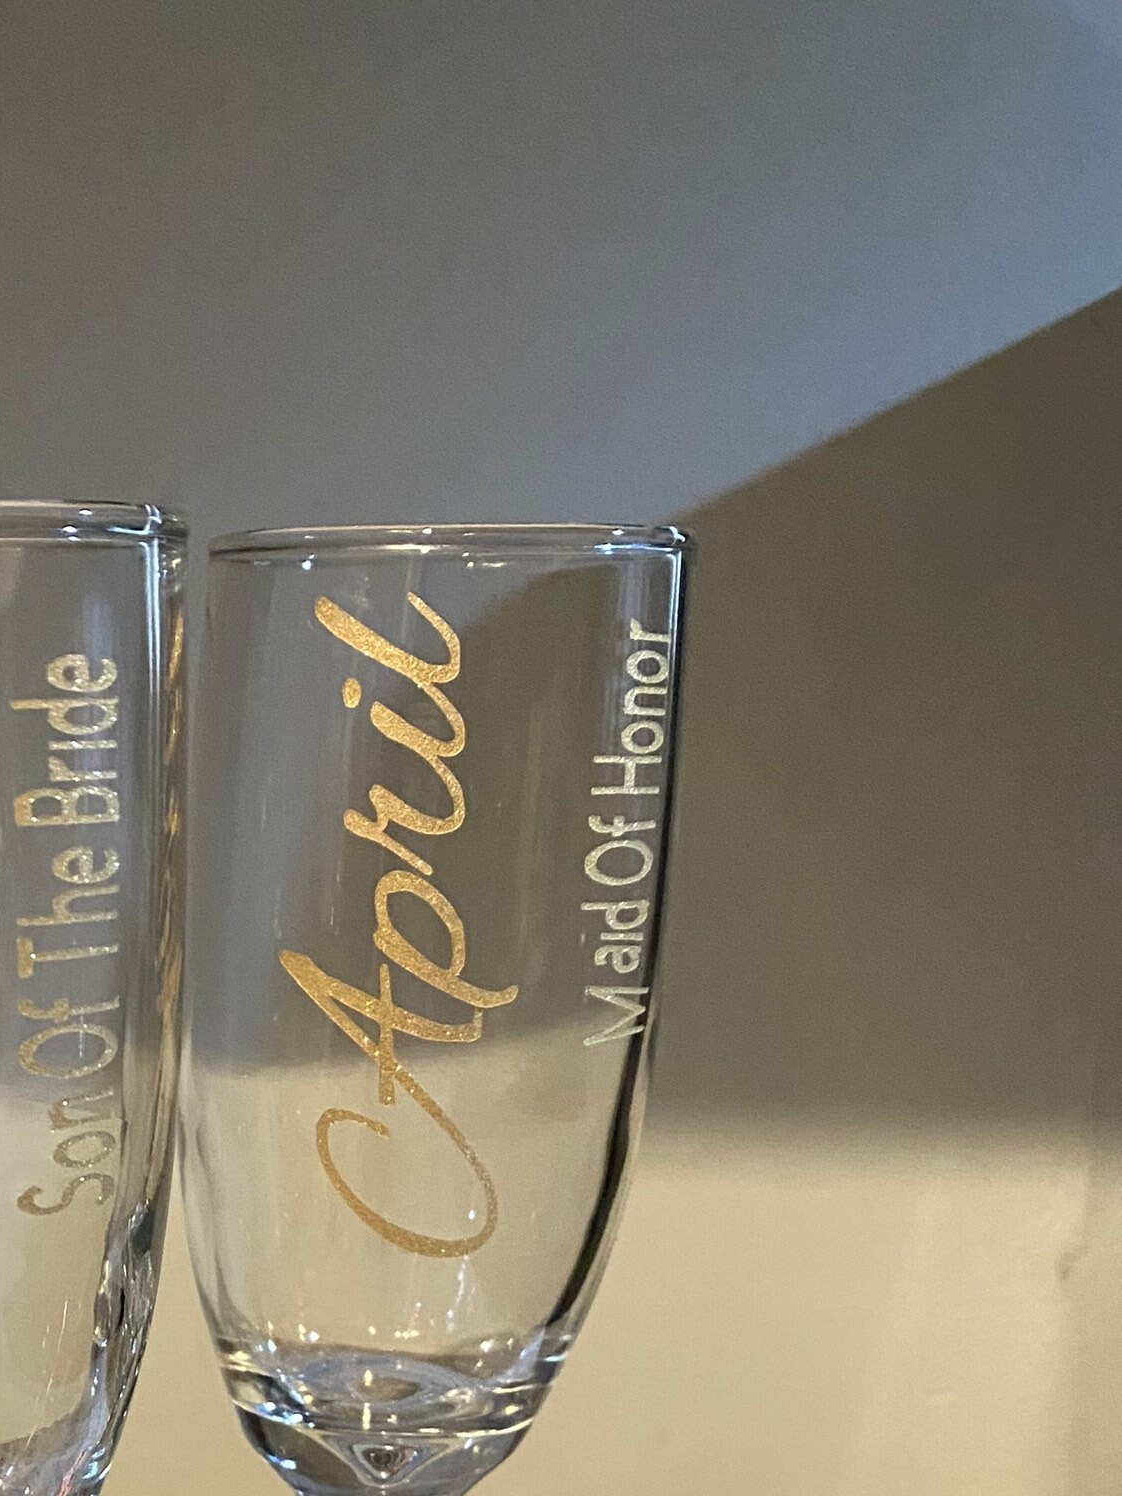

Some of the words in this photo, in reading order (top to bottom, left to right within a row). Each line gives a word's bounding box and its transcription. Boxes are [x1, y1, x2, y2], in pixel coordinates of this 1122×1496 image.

[10, 652, 119, 829] Bride
[592, 617, 674, 796] Honor
[16, 848, 120, 981] The
[583, 814, 657, 887] Of
[279, 590, 519, 1259] April
[581, 899, 651, 1048] Maid
[18, 993, 118, 1077] Of
[16, 1089, 124, 1217] Son
